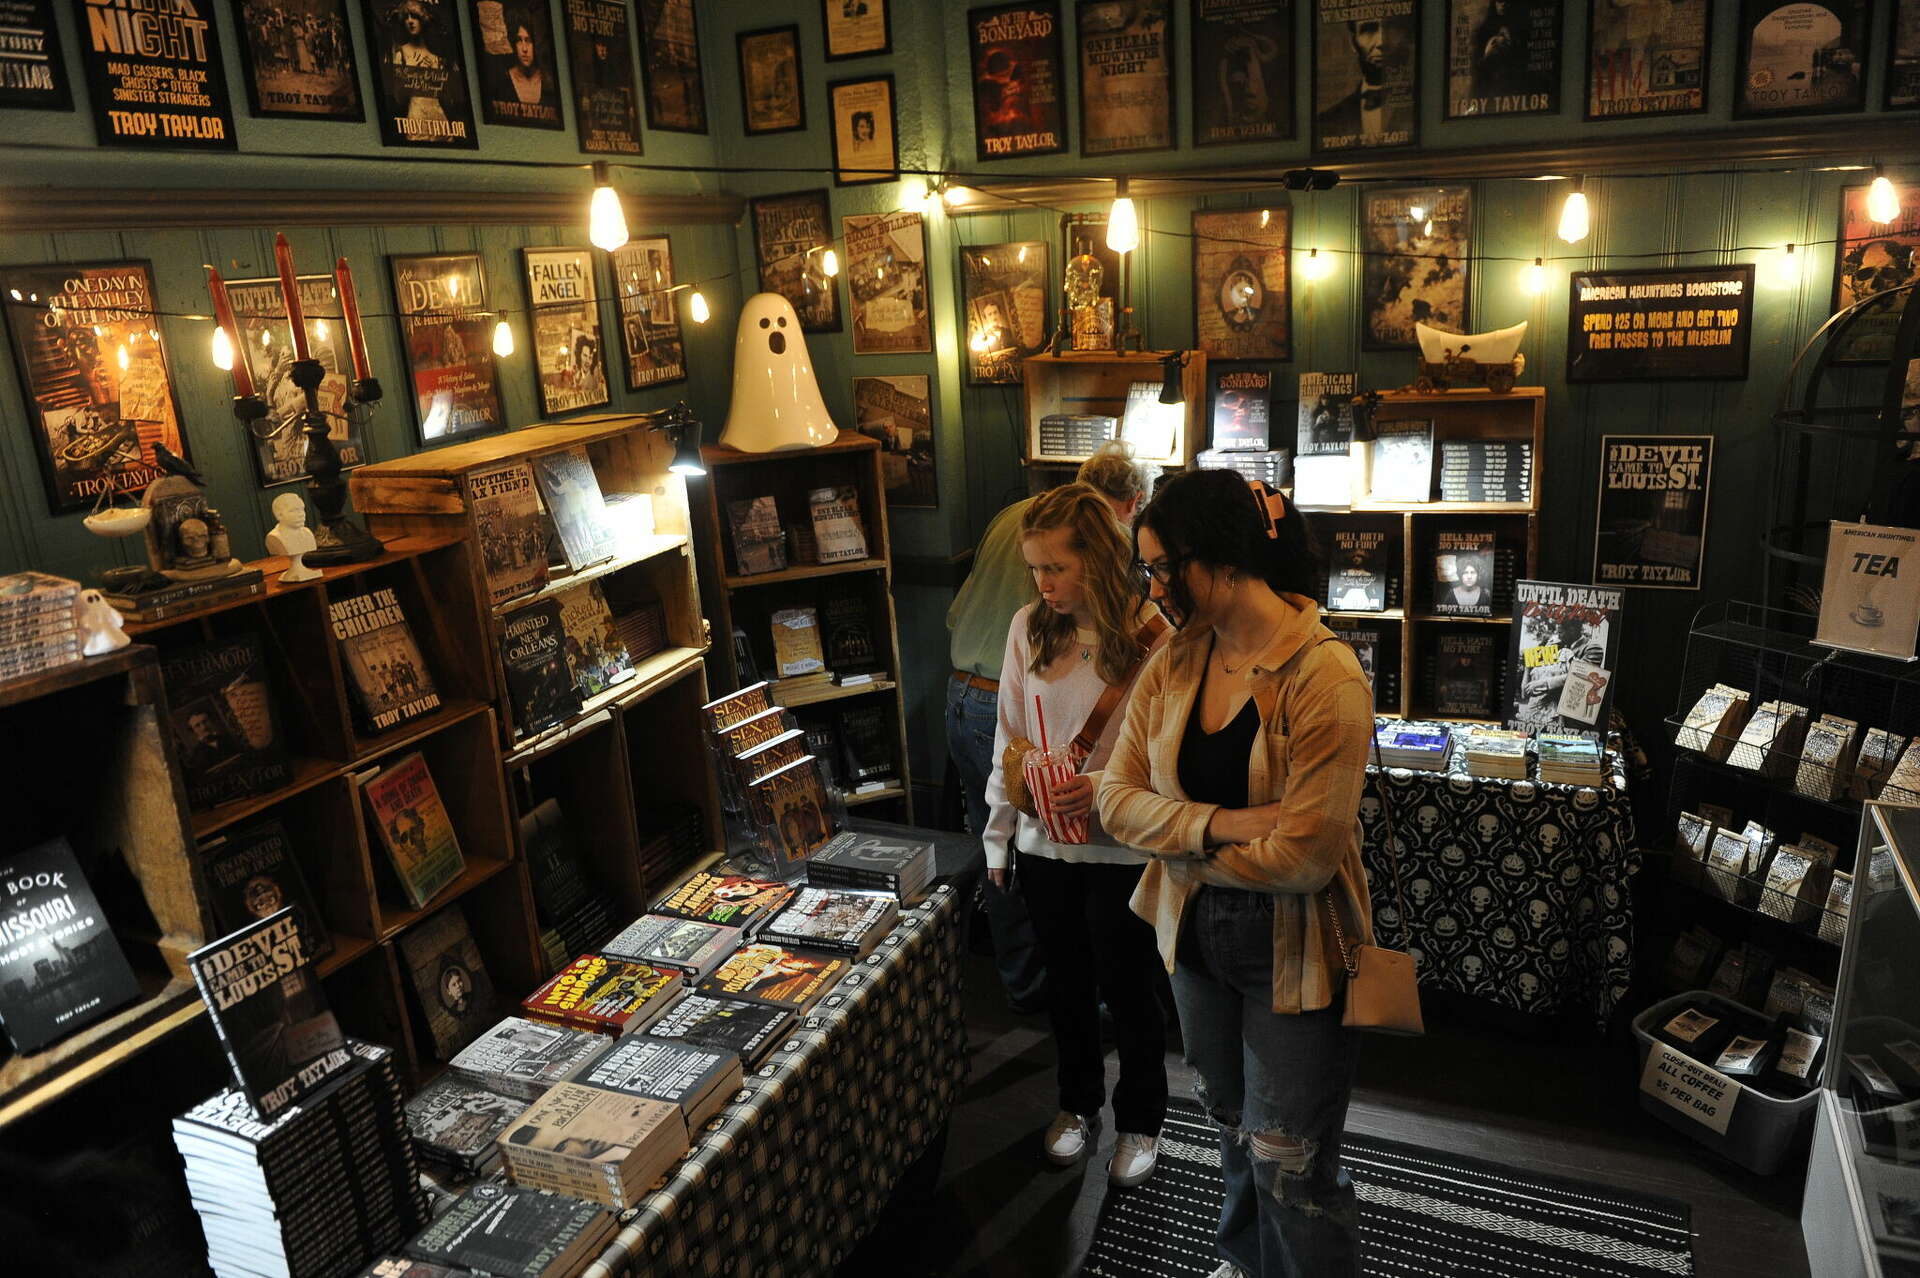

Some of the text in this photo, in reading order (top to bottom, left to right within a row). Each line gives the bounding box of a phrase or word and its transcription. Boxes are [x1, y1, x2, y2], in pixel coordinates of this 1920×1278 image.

[1320, 1, 1414, 23] WASHINGTON
[85, 6, 209, 63] NIGHT
[980, 19, 1052, 43] BONEYARD
[1087, 33, 1160, 53] ONE BLEAK
[1089, 47, 1160, 66] MIDWINTER
[107, 62, 131, 76] MAD
[178, 68, 208, 83] BLACK
[1100, 61, 1147, 77] NIGHT
[121, 76, 200, 94] GHOSTS OTHER
[112, 88, 212, 107] SINISTER STRANGERS
[267, 92, 301, 105] TROY
[1494, 93, 1550, 111] TAYLOR
[107, 110, 225, 140] TROY TAYLOR
[394, 117, 467, 138] TROY TAYLOR
[985, 132, 1058, 153] TROY TAYLOR
[1322, 134, 1356, 148] TROY
[533, 263, 582, 281] FALLEN
[64, 274, 143, 294] ONE DAY IN
[409, 278, 481, 312] DEVIL
[540, 282, 581, 300] ANGEL
[1580, 280, 1743, 302] AMERICAN HAUNTINGS BOOKSTORE
[49, 291, 145, 309] THE VALLEY
[44, 305, 150, 328] OF THE KINGS
[1583, 308, 1739, 332] SPEND $25 OR MORE AND GET TWO
[1589, 329, 1733, 350] FREE PASSES TO THE MUSEUM
[637, 365, 681, 385] TROY TAYLOR
[1300, 374, 1353, 387] AMERICAN
[1300, 384, 1352, 396] HAUNTINGS
[1618, 444, 1704, 468] DEVIL
[72, 473, 117, 498] TROY
[470, 470, 514, 490] VICTIMS
[490, 477, 530, 496] FIEND
[1607, 473, 1667, 490] LOUIS
[1609, 462, 1703, 490] CAME TO ST.
[1335, 532, 1384, 542] HELL HATH
[1340, 541, 1378, 550] NO FURY
[1439, 532, 1493, 543] HELL HATH
[1843, 528, 1915, 542] AMERICAN HAUNTINGS
[1439, 542, 1480, 551] NO FURY
[1601, 564, 1692, 582] TROY TAYLOR
[1852, 553, 1900, 578] TEA
[494, 586, 515, 599] TROY
[1517, 584, 1620, 610] UNTIL DEATH
[329, 587, 398, 622] SUFFER THE
[1436, 605, 1491, 615] TROY TAYLOR
[332, 604, 405, 641] CHILDREN
[505, 616, 549, 638] HAUNTED
[520, 631, 539, 646] NEW
[1351, 631, 1378, 642] DEATH
[1524, 645, 1560, 667] NEW!
[372, 693, 441, 729] TROY TAYLOR
[713, 696, 747, 718] SEX
[731, 722, 762, 743] SEX
[1507, 720, 1543, 738] TROY
[752, 747, 784, 766] SEX
[6, 872, 67, 896] BOOK
[664, 871, 712, 910] HAUNTING
[685, 876, 724, 910] AMERICA
[0, 893, 77, 946] ISSOURI
[214, 915, 299, 976] DEVIL
[211, 935, 310, 992] CAME TO ST.
[214, 962, 279, 1011] LOUIS
[543, 974, 577, 1005] INTO
[559, 957, 607, 1010] SHADOWS
[647, 993, 705, 1037] SEASON
[666, 996, 721, 1039] WITCH
[741, 1009, 789, 1052] TROY TAYLOR
[549, 1038, 603, 1078] TROY TAYLOR
[677, 1051, 705, 1072] STORY
[1658, 1062, 1724, 1101] ALL COFFEE
[1662, 1052, 1727, 1089] CLOSE-OUT DEAL!
[260, 1049, 351, 1115] TROY TAYLOR
[550, 1088, 600, 1127] BIOGRAPH
[1656, 1079, 1716, 1116] $5 PER BAG
[414, 1207, 464, 1248] CABINET
[455, 1196, 477, 1210] OF
[424, 1196, 491, 1253] CURIOSITIES
[519, 1246, 560, 1274] TROY
[548, 1207, 600, 1245] TAYLOR
